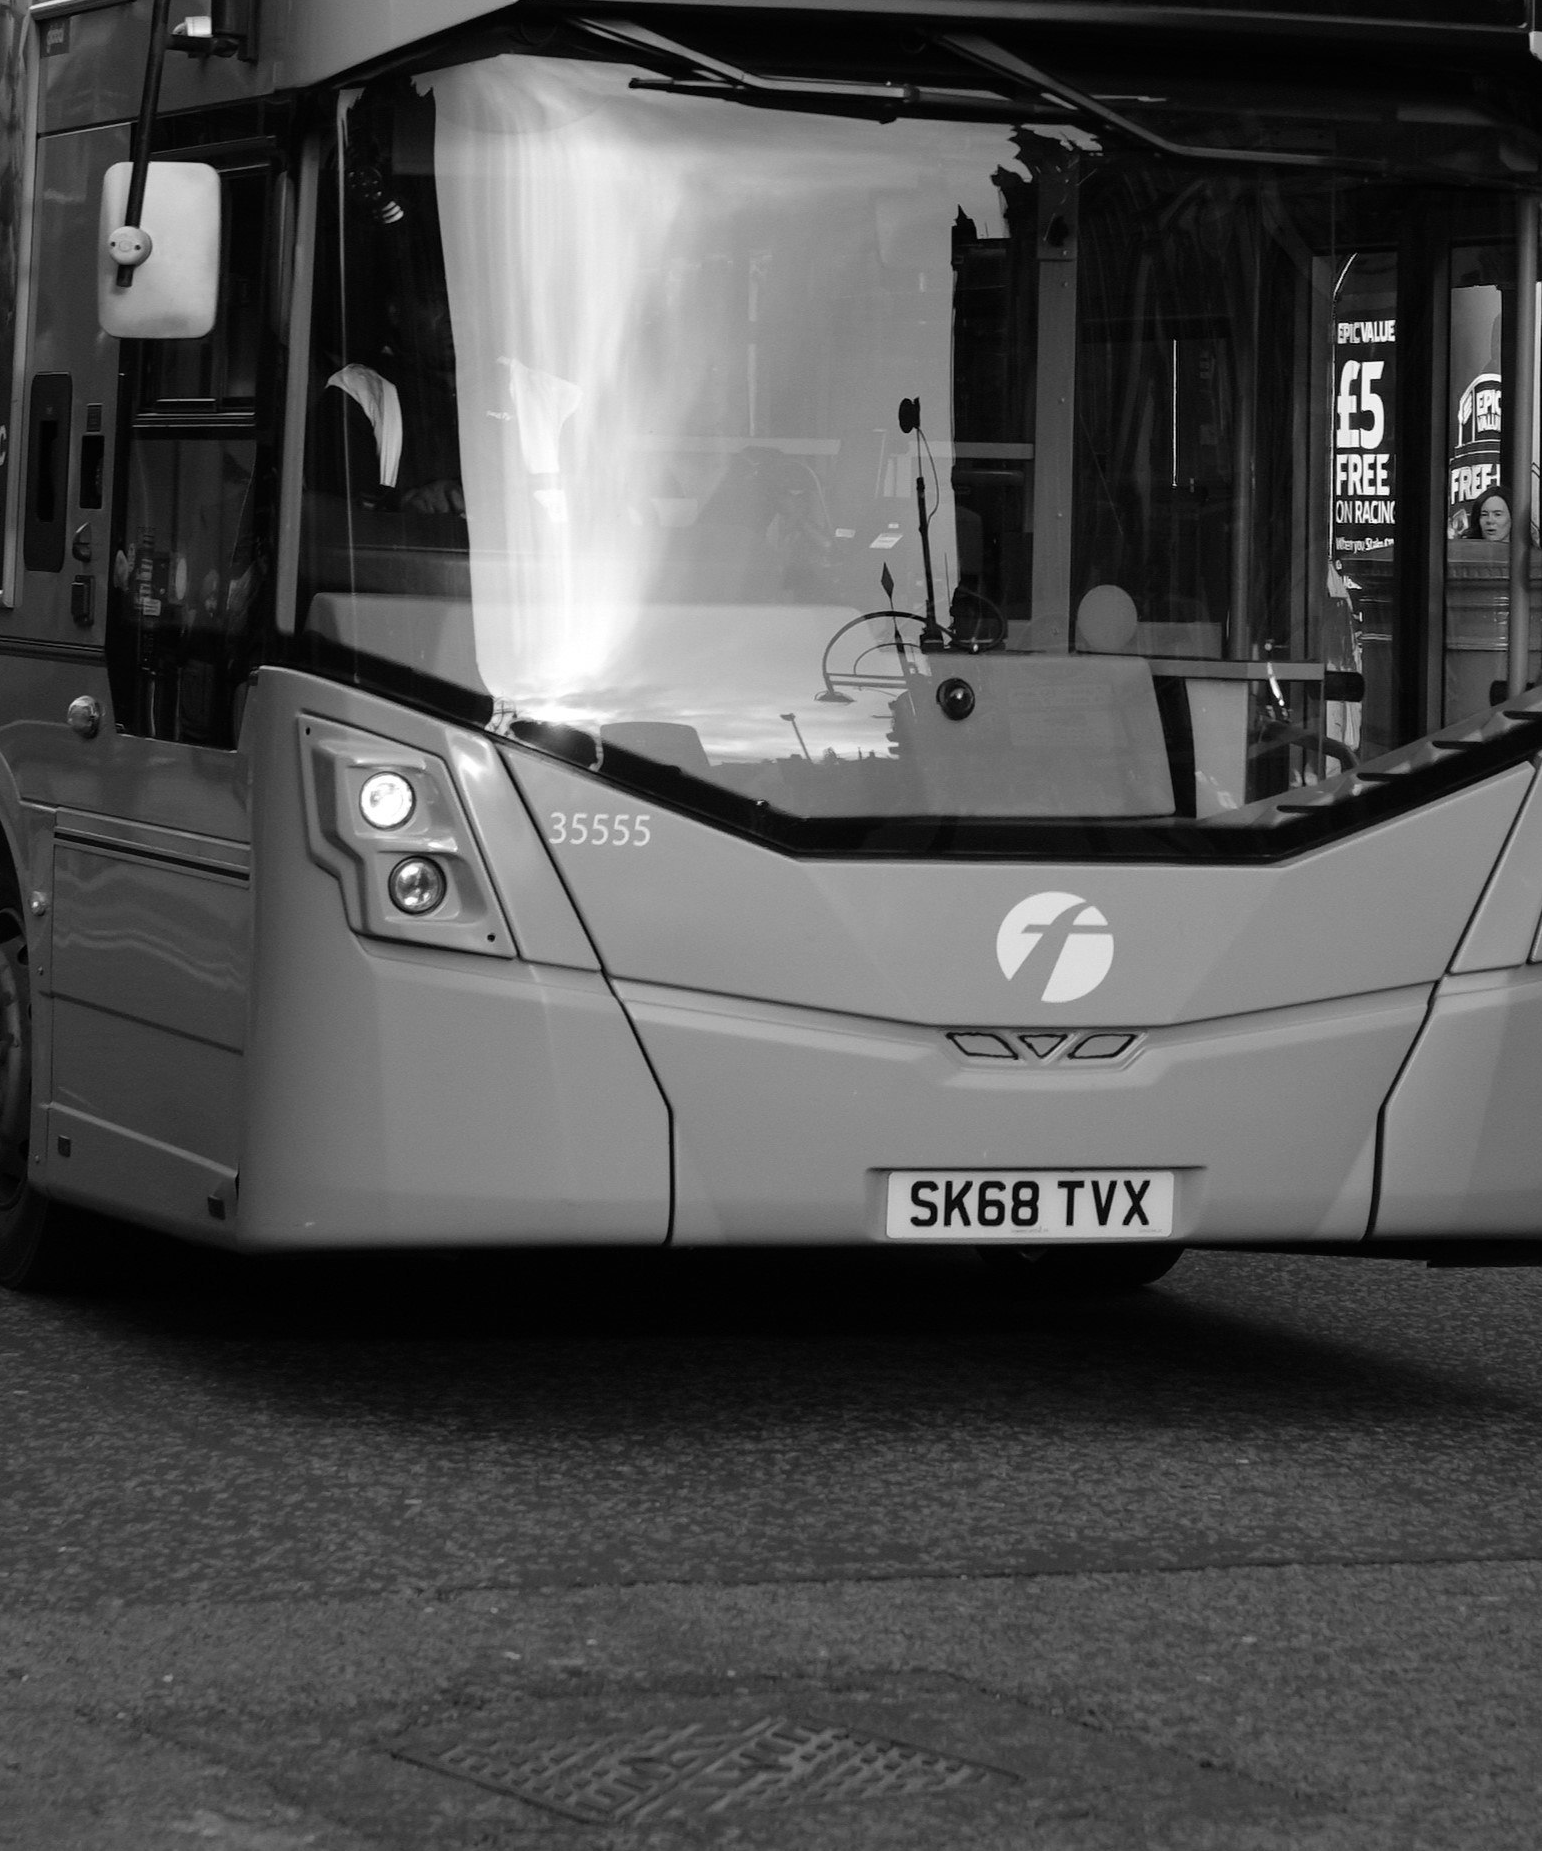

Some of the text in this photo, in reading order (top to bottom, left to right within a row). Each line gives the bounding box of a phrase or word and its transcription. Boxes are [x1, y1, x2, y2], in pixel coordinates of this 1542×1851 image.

[1337, 319, 1397, 345] EPIC VALUE
[1336, 359, 1385, 450] £5
[1477, 413, 1501, 433] VALU
[1336, 453, 1391, 497] FREE
[1336, 500, 1353, 524] ON
[548, 811, 651, 847] 35555
[910, 1179, 1151, 1227] SK68 TVX
